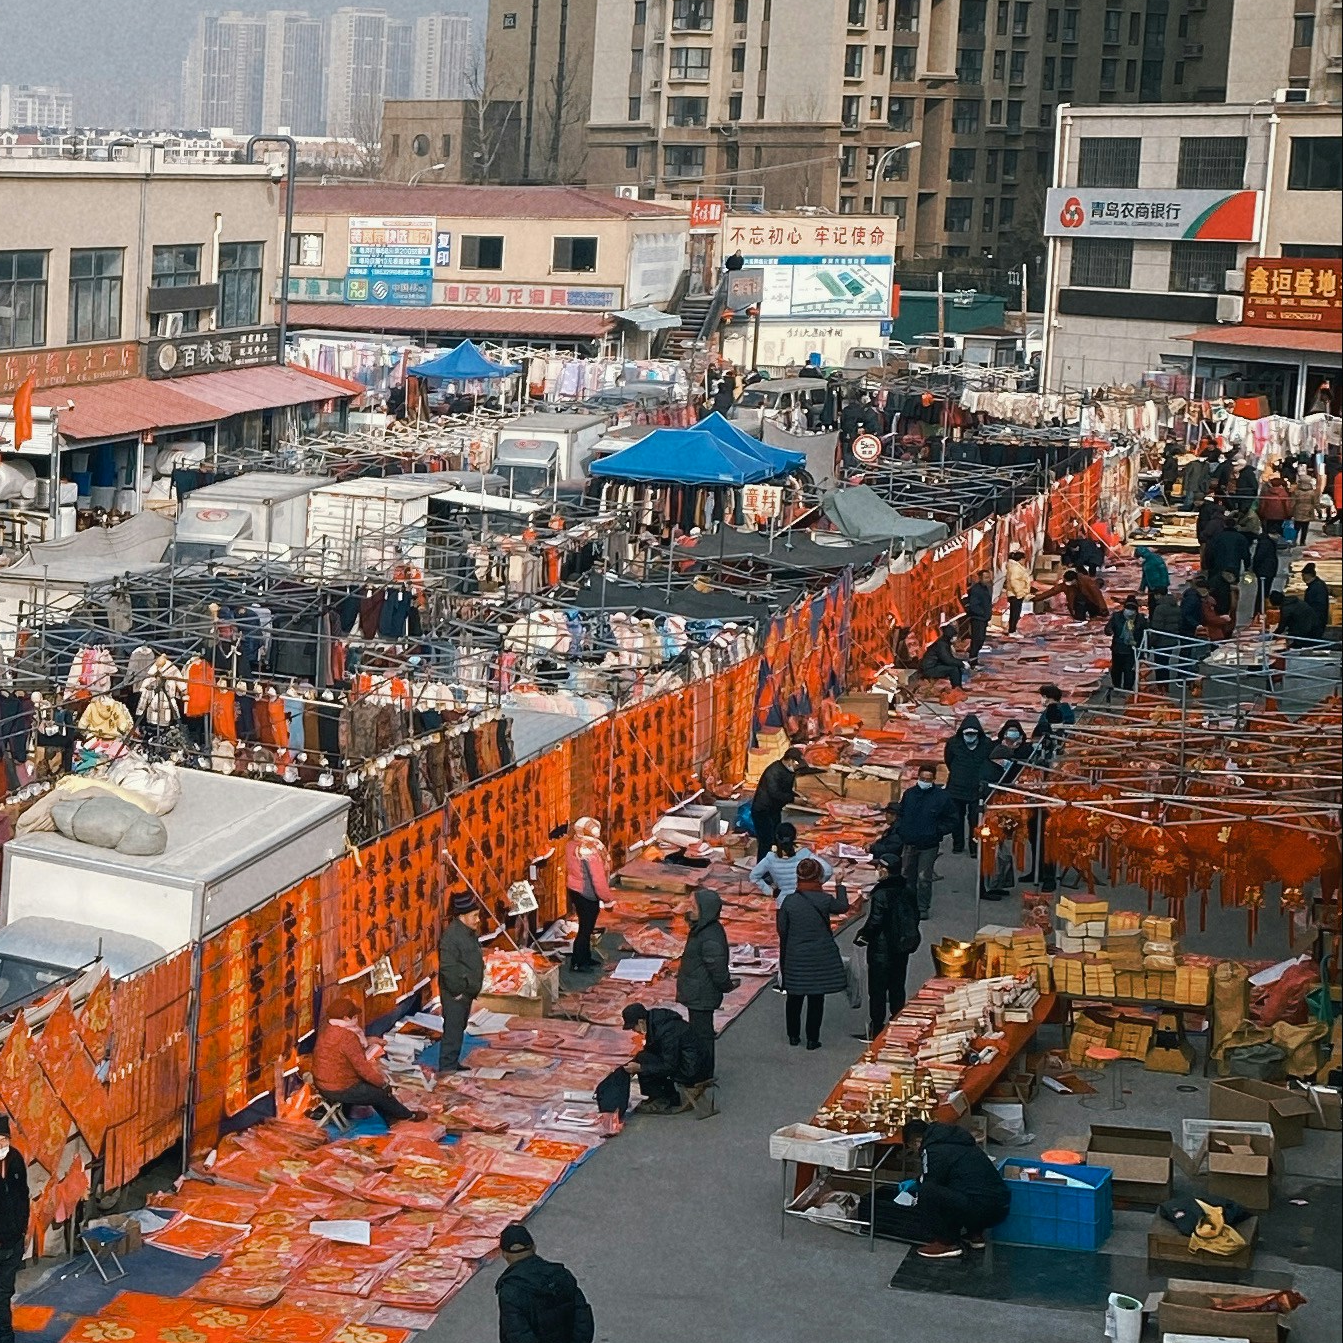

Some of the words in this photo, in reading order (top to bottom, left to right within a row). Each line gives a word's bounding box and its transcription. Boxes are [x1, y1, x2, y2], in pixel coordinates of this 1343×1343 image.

[1091, 201, 1181, 220] 青岛农商银行
[436, 232, 450, 266] 复印
[730, 226, 802, 246] 不忘初心
[814, 226, 885, 246] 牢记使命
[1249, 265, 1342, 298] 鑫垣盛地
[179, 339, 233, 367] 百味源
[744, 487, 778, 515] 童鞋
